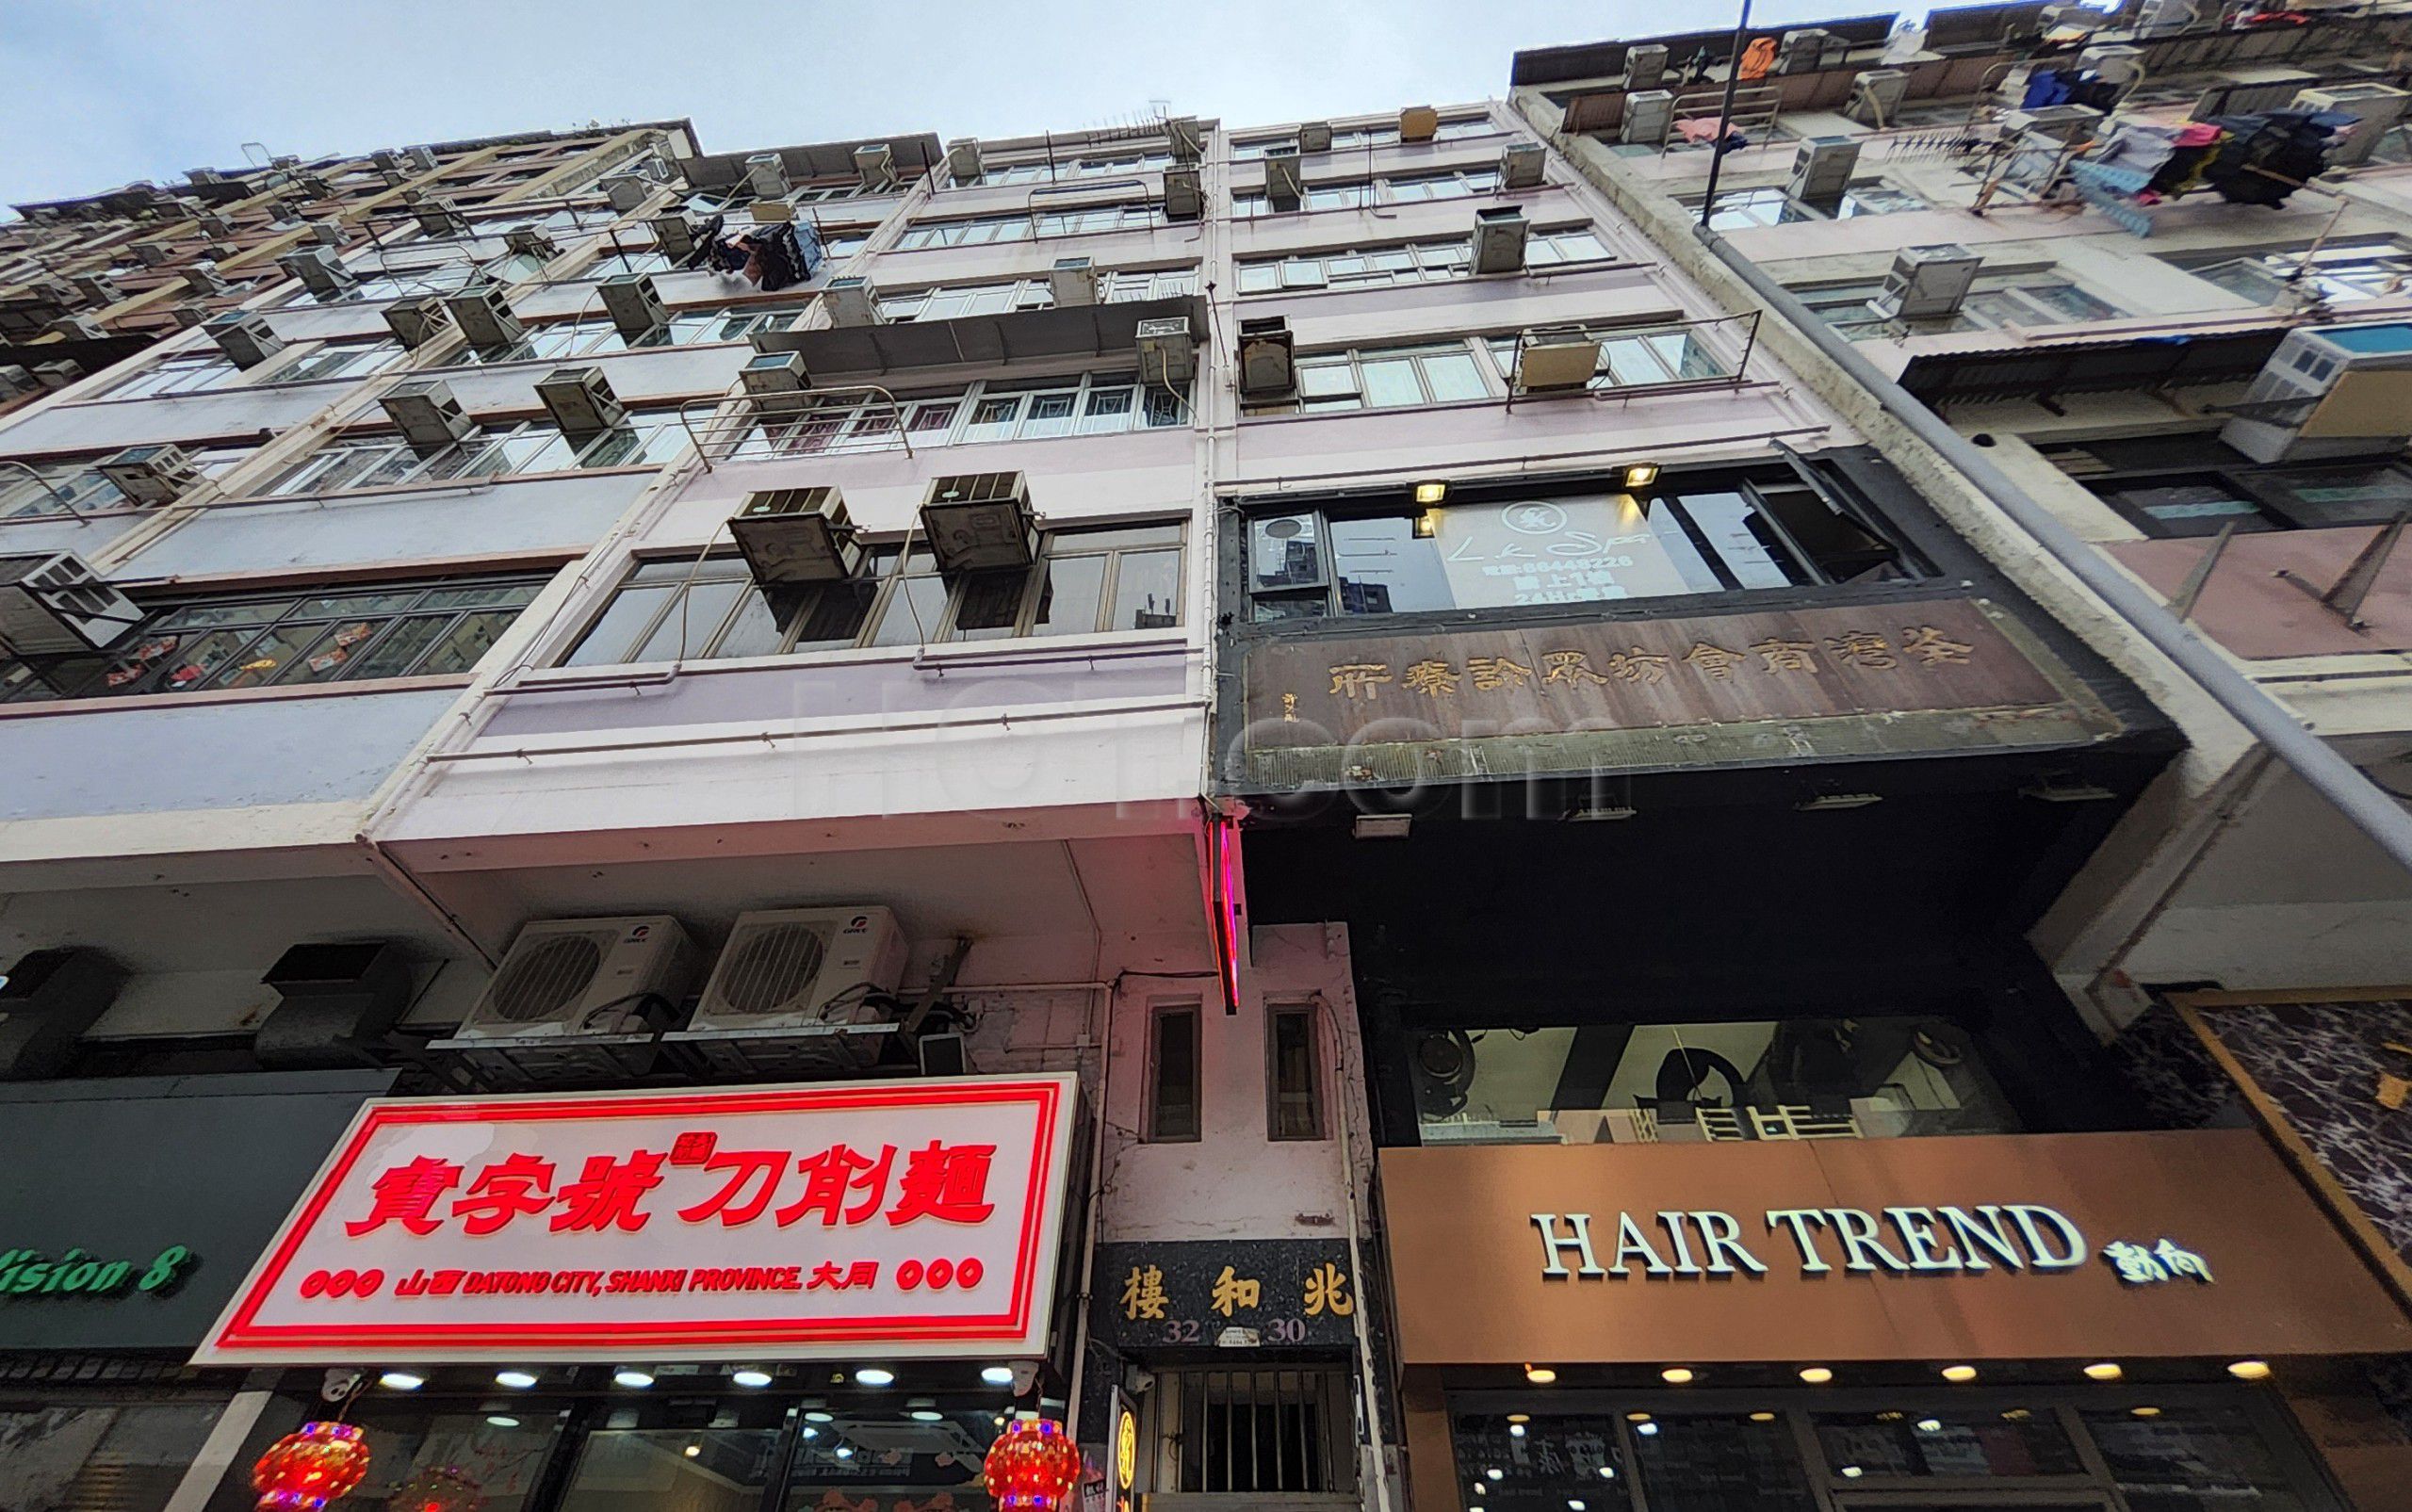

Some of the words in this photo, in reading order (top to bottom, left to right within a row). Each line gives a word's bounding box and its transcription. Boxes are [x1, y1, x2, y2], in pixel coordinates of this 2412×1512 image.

[1530, 1211, 1768, 1276] HAIR
[1767, 1204, 2087, 1272] TREND
[0, 1247, 131, 1293] ision
[139, 1244, 188, 1292] 8
[394, 1268, 468, 1296] 山西
[463, 1270, 551, 1295] DATONG
[604, 1268, 689, 1293] SHANXI
[807, 1260, 880, 1291] 大同
[1162, 1320, 1201, 1344] 32
[1267, 1319, 1307, 1342] 30
